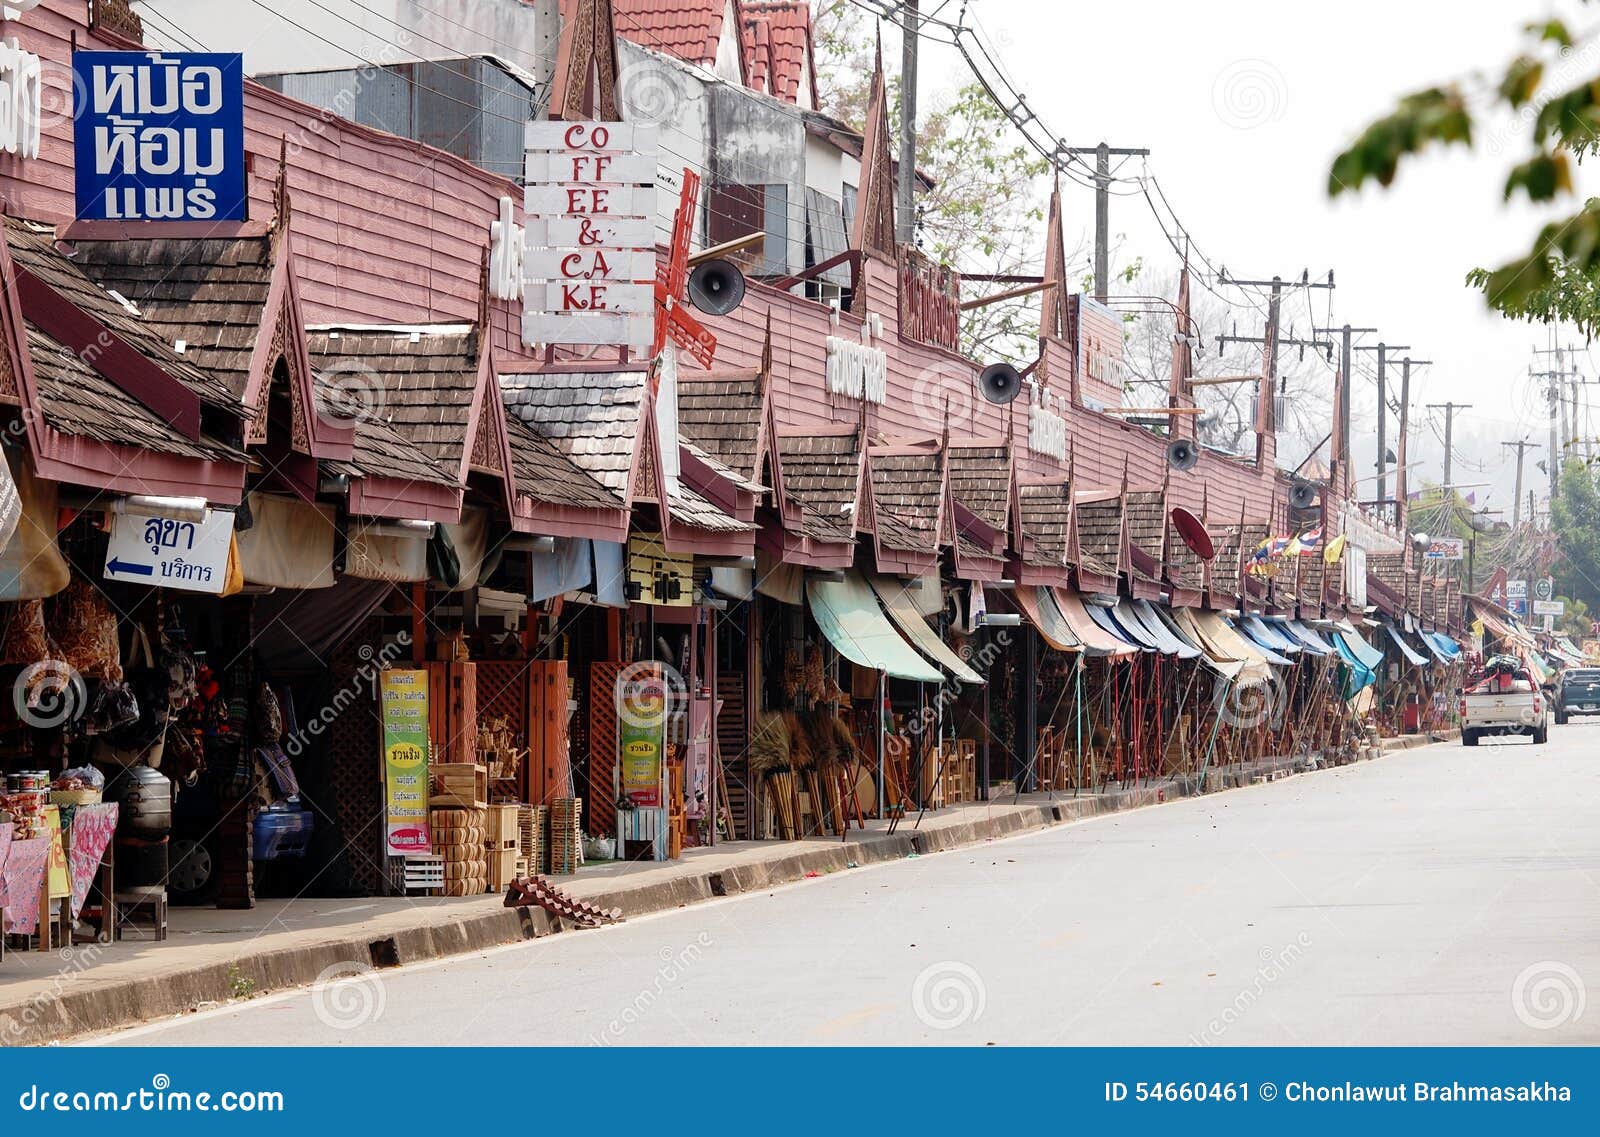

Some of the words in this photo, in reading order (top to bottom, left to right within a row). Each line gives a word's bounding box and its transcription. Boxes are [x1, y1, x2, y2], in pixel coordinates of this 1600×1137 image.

[92, 53, 222, 115] หม้อ
[95, 114, 224, 176] ห้อม
[564, 124, 609, 149] CO
[572, 156, 611, 181] FF
[105, 178, 217, 219] แพร่
[566, 189, 609, 214] EE
[578, 218, 603, 245] &
[560, 250, 612, 279] CA
[562, 284, 607, 310] KE
[144, 517, 195, 555] สุขา
[160, 557, 213, 582] บริการ
[391, 747, 420, 761] ชวนชิม
